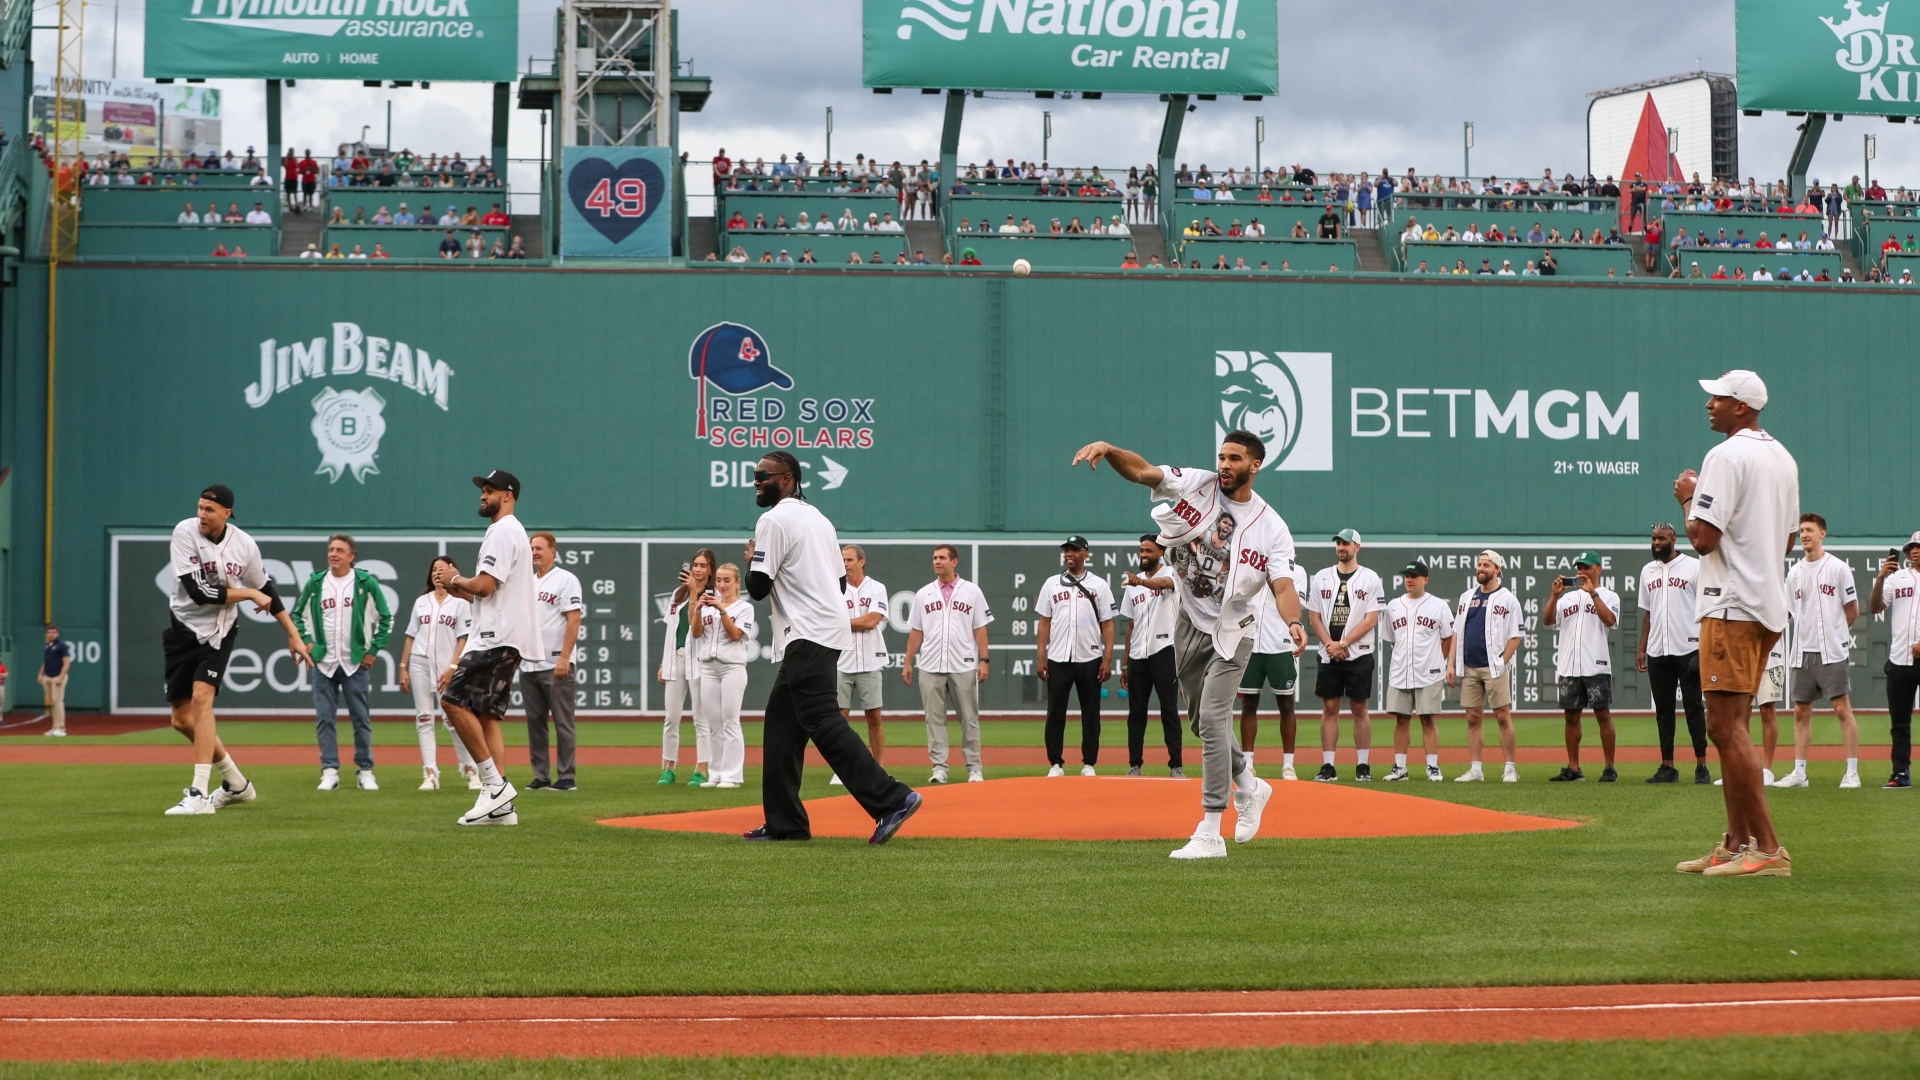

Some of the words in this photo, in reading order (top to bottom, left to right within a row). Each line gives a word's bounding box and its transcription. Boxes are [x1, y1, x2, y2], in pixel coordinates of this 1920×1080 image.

[978, 0, 1237, 39] National
[345, 19, 473, 37] assurance
[283, 53, 319, 64] AUTO
[340, 53, 379, 64] HOME
[1071, 44, 1122, 68] Car
[1132, 46, 1230, 70] Rental
[1836, 30, 1920, 72] DR
[585, 178, 646, 218] 49
[244, 337, 327, 408] JIM
[331, 322, 450, 411] BEAM
[711, 397, 785, 422] RED
[798, 398, 875, 423] SOX
[1351, 387, 1640, 440] BETMGM
[341, 417, 356, 435] B
[709, 426, 874, 449] SCHOLARS
[710, 460, 811, 488] BIDC
[1554, 461, 1574, 475] 21+
[1577, 461, 1593, 475] TO
[1595, 461, 1640, 475] WAGER
[1173, 499, 1202, 527] RED
[1239, 549, 1269, 572] SOX
[592, 580, 616, 595] GB
[1014, 574, 1026, 588] P
[1526, 576, 1536, 591] P
[1625, 576, 1635, 591] R
[1668, 578, 1688, 591] SOX
[537, 591, 557, 605] SOX
[1052, 590, 1070, 605] RED
[1895, 587, 1914, 599] RED
[924, 600, 943, 615] RED
[952, 601, 973, 615] SOX
[1012, 597, 1027, 612] 40
[1524, 598, 1538, 613] 46
[1563, 604, 1578, 618] RED
[1012, 620, 1027, 635] 89
[1392, 616, 1407, 631] RED
[1416, 616, 1436, 630] SOX
[1524, 616, 1538, 631] 47
[1524, 634, 1538, 649] 65
[598, 646, 609, 662] 9
[1524, 652, 1538, 667] 45
[1012, 660, 1033, 675] AT
[595, 668, 612, 684] 13
[1526, 670, 1537, 684] 71
[595, 690, 612, 706] 15
[1524, 687, 1538, 702] 55
